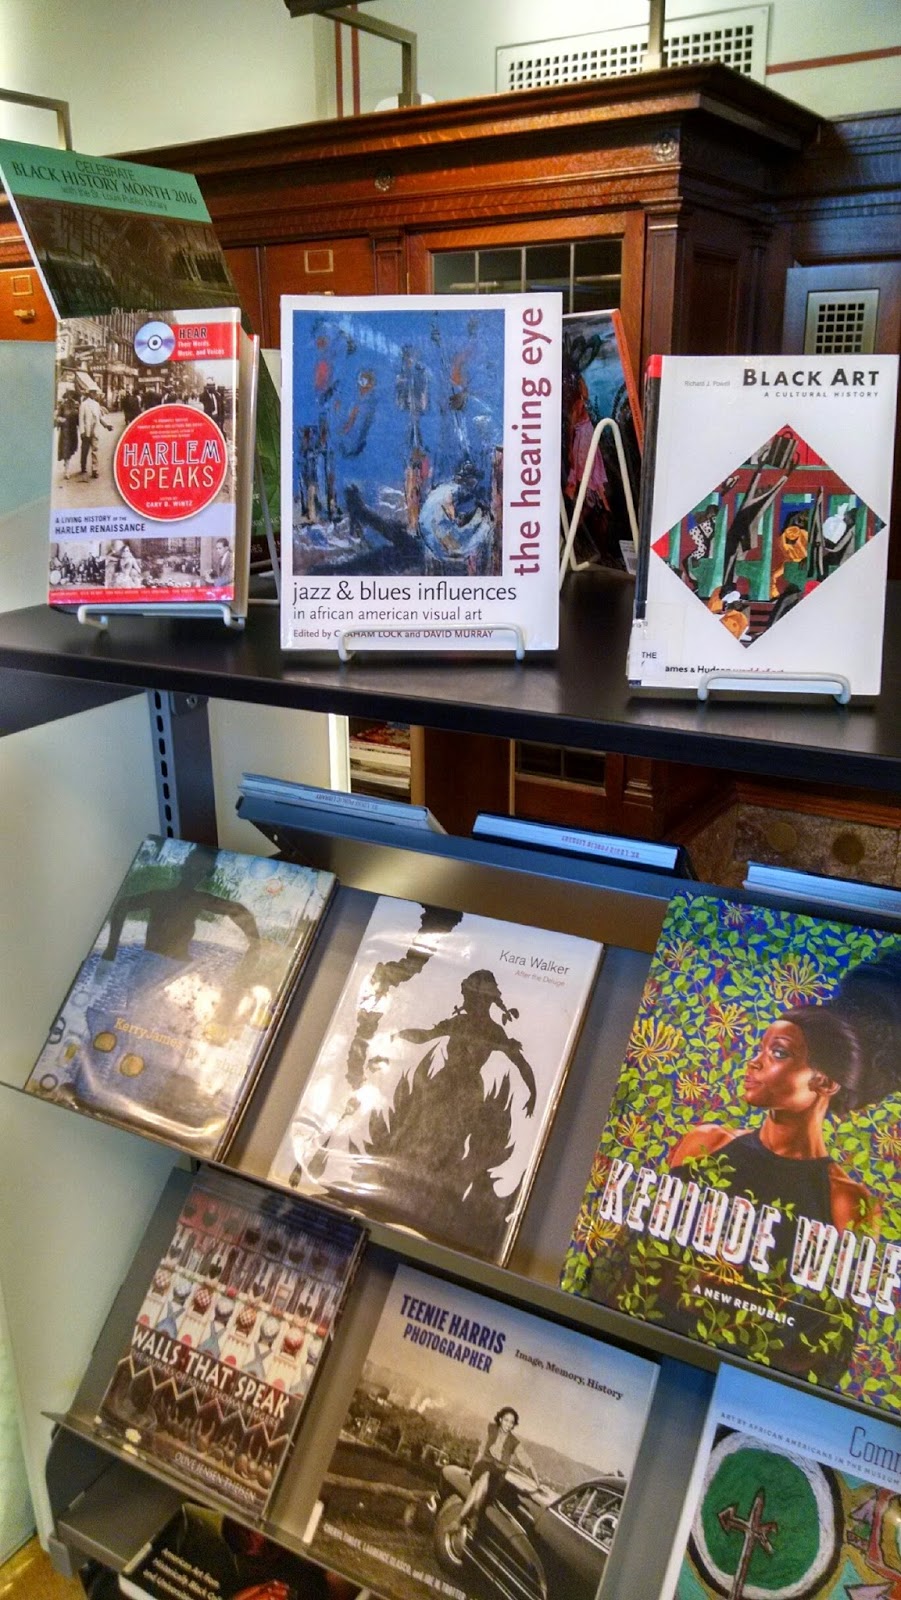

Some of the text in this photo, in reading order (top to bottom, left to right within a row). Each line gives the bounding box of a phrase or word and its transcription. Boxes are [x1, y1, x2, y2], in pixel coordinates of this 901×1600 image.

[12, 161, 198, 205] BLACK HISTORY MONTH 2016
[75, 160, 135, 180] CELEBRATE
[178, 327, 208, 339] HEAR
[742, 368, 880, 387] BLACK ART
[123, 440, 221, 467] HARLEM
[510, 308, 552, 576] the hearing eye
[129, 465, 215, 490] SPEAKS
[55, 523, 146, 534] HARLEM RENAISSANCE
[61, 515, 82, 524] LIVING
[84, 511, 111, 523] HISTORY
[293, 581, 517, 605] jazz & blues influences
[293, 606, 482, 620] in african american visual art
[293, 629, 494, 640] Edited by GAHAM LOCK and DAVID MURRAY
[641, 651, 657, 659] THE
[665, 665, 688, 673] ames
[499, 949, 570, 975] Kara Walker
[515, 970, 531, 978] After
[542, 976, 566, 988] Deluge
[114, 1017, 148, 1039] Kerry
[147, 1030, 184, 1050] James
[600, 1158, 781, 1274] KEHINDE
[693, 1284, 795, 1327] A NEW REPUBLIC
[399, 1294, 506, 1354] TEENIE HARRIS
[403, 1323, 493, 1374] PHOTOGRAPHER
[131, 1324, 290, 1419] WALLS THAT SPEAK
[515, 1349, 625, 1401] Image, Memory, History
[146, 1356, 175, 1374] MURALS
[187, 1375, 209, 1392] JOHN
[211, 1389, 246, 1410] THOMAS
[247, 1407, 281, 1427] BIGGERS
[721, 1412, 901, 1484] ART BY AFRICAN AMERICANS IN THE MUSEUM
[174, 1452, 197, 1470] OLIVE
[195, 1463, 222, 1484] JENSEN
